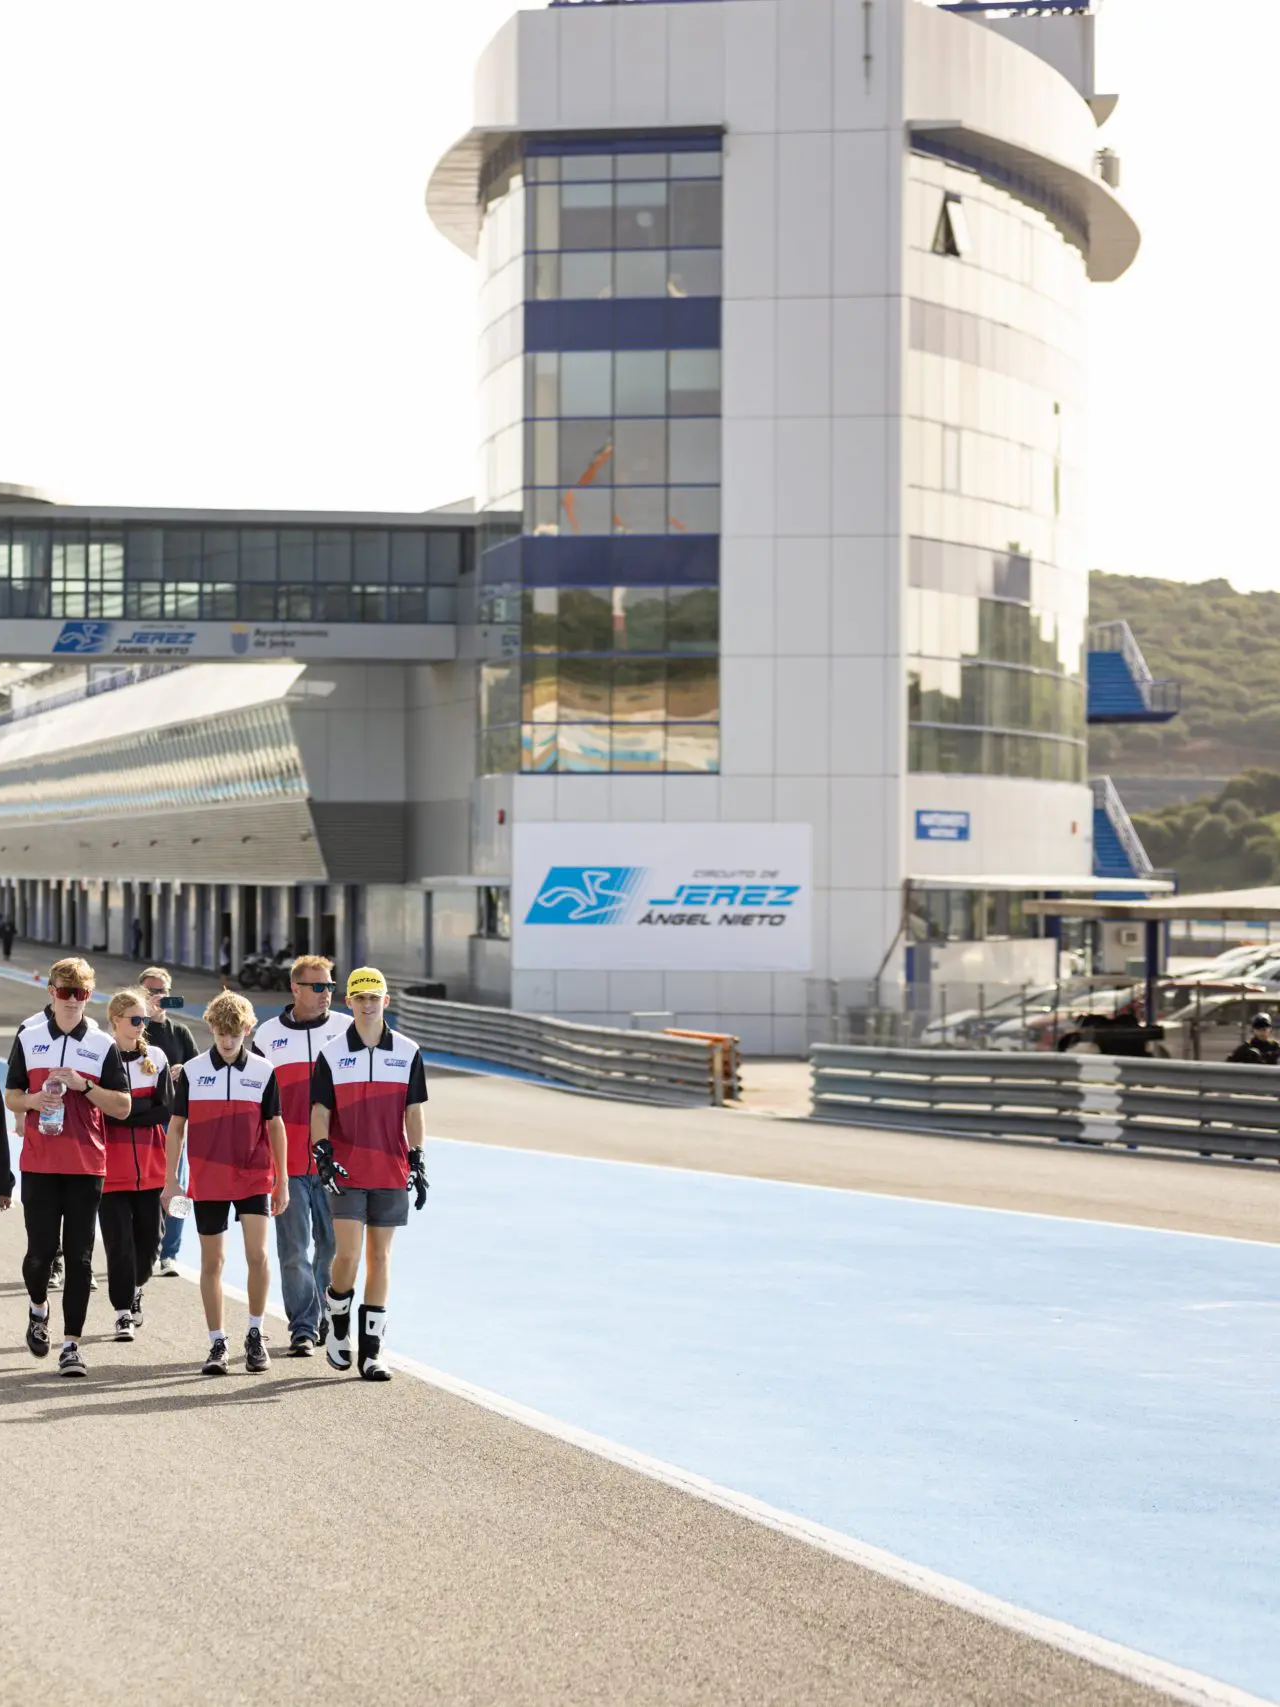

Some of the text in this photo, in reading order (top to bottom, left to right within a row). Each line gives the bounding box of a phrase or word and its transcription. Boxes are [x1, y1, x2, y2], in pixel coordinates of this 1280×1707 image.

[117, 632, 196, 644] JEREZ
[692, 869, 780, 879] CIRCUITO DE
[649, 885, 801, 906] JEREZ
[638, 910, 787, 926] ÁNGEL NIETO
[351, 977, 382, 987] DUNLOP
[270, 1038, 288, 1048] FIM
[32, 1044, 50, 1053] FIM
[338, 1057, 356, 1066] FIM
[197, 1076, 216, 1084] FIM
